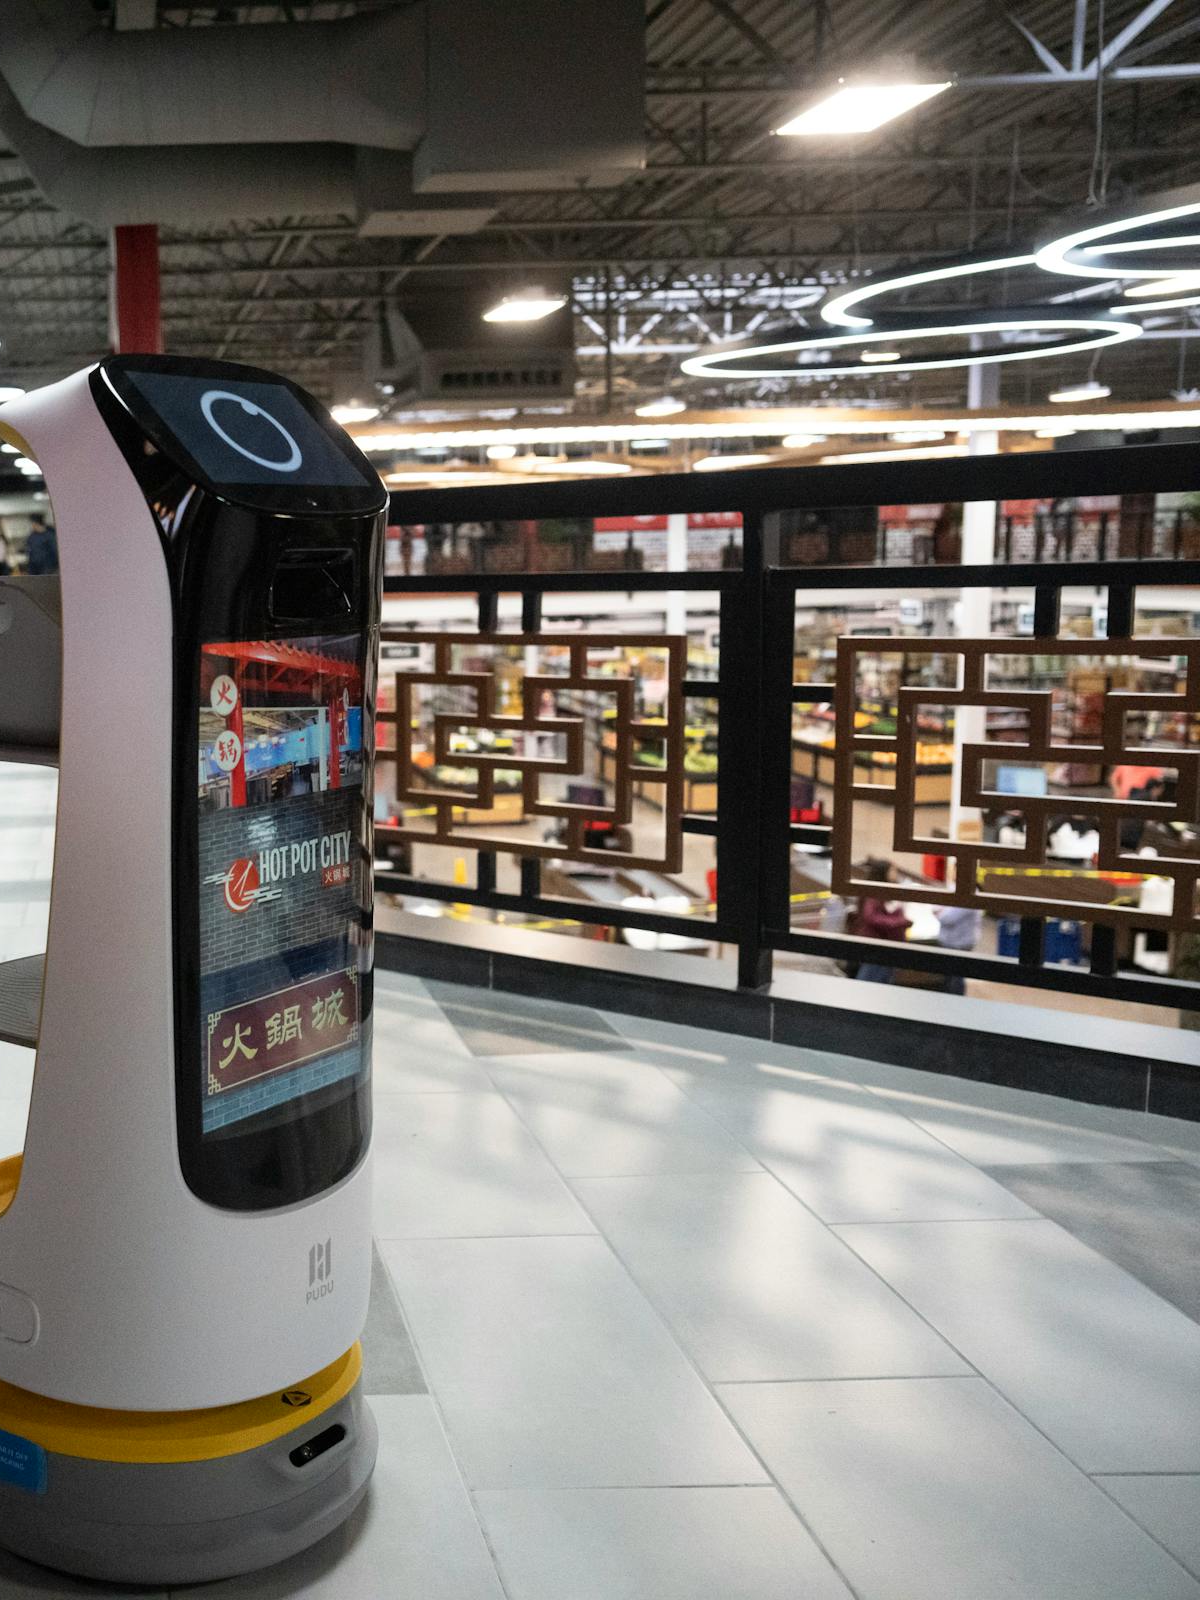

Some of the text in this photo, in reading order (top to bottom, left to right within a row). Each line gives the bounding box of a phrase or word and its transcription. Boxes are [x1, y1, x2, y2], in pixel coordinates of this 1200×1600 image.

[215, 681, 233, 706] 火
[259, 830, 352, 884] HOT POT CITY
[218, 987, 349, 1070] 火鍋城
[305, 1279, 334, 1305] PUDU
